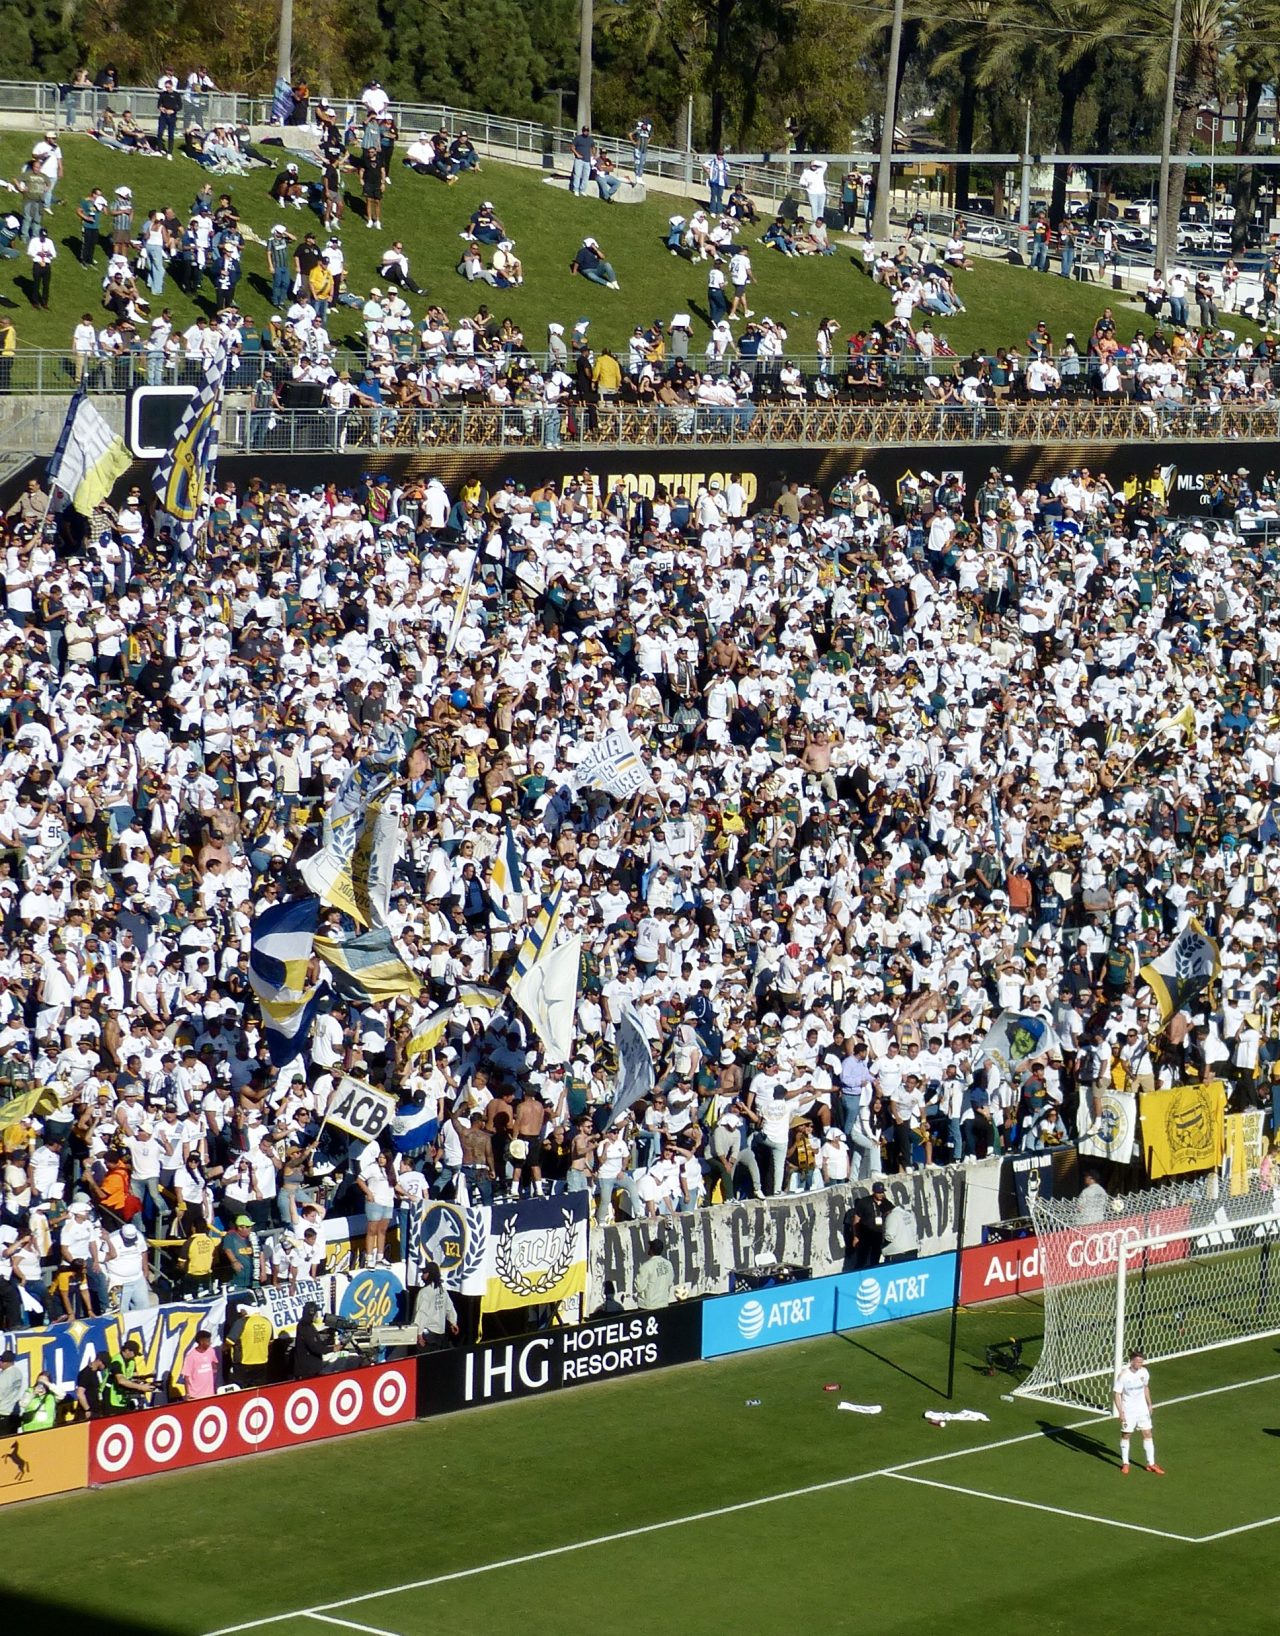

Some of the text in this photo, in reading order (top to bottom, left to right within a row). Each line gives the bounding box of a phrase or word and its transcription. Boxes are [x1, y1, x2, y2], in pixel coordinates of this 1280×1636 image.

[1177, 473, 1205, 491] MLS
[657, 724, 679, 732] GALAXY
[332, 1088, 388, 1136] ACB
[731, 1201, 815, 1270] CITY
[984, 1248, 1046, 1287] Audi
[884, 1273, 929, 1305] AT&T
[271, 1302, 289, 1314] LOS
[767, 1295, 815, 1329] AT&T
[463, 1316, 660, 1401] IHG HOTELS &
[563, 1342, 658, 1381] RESORTS
